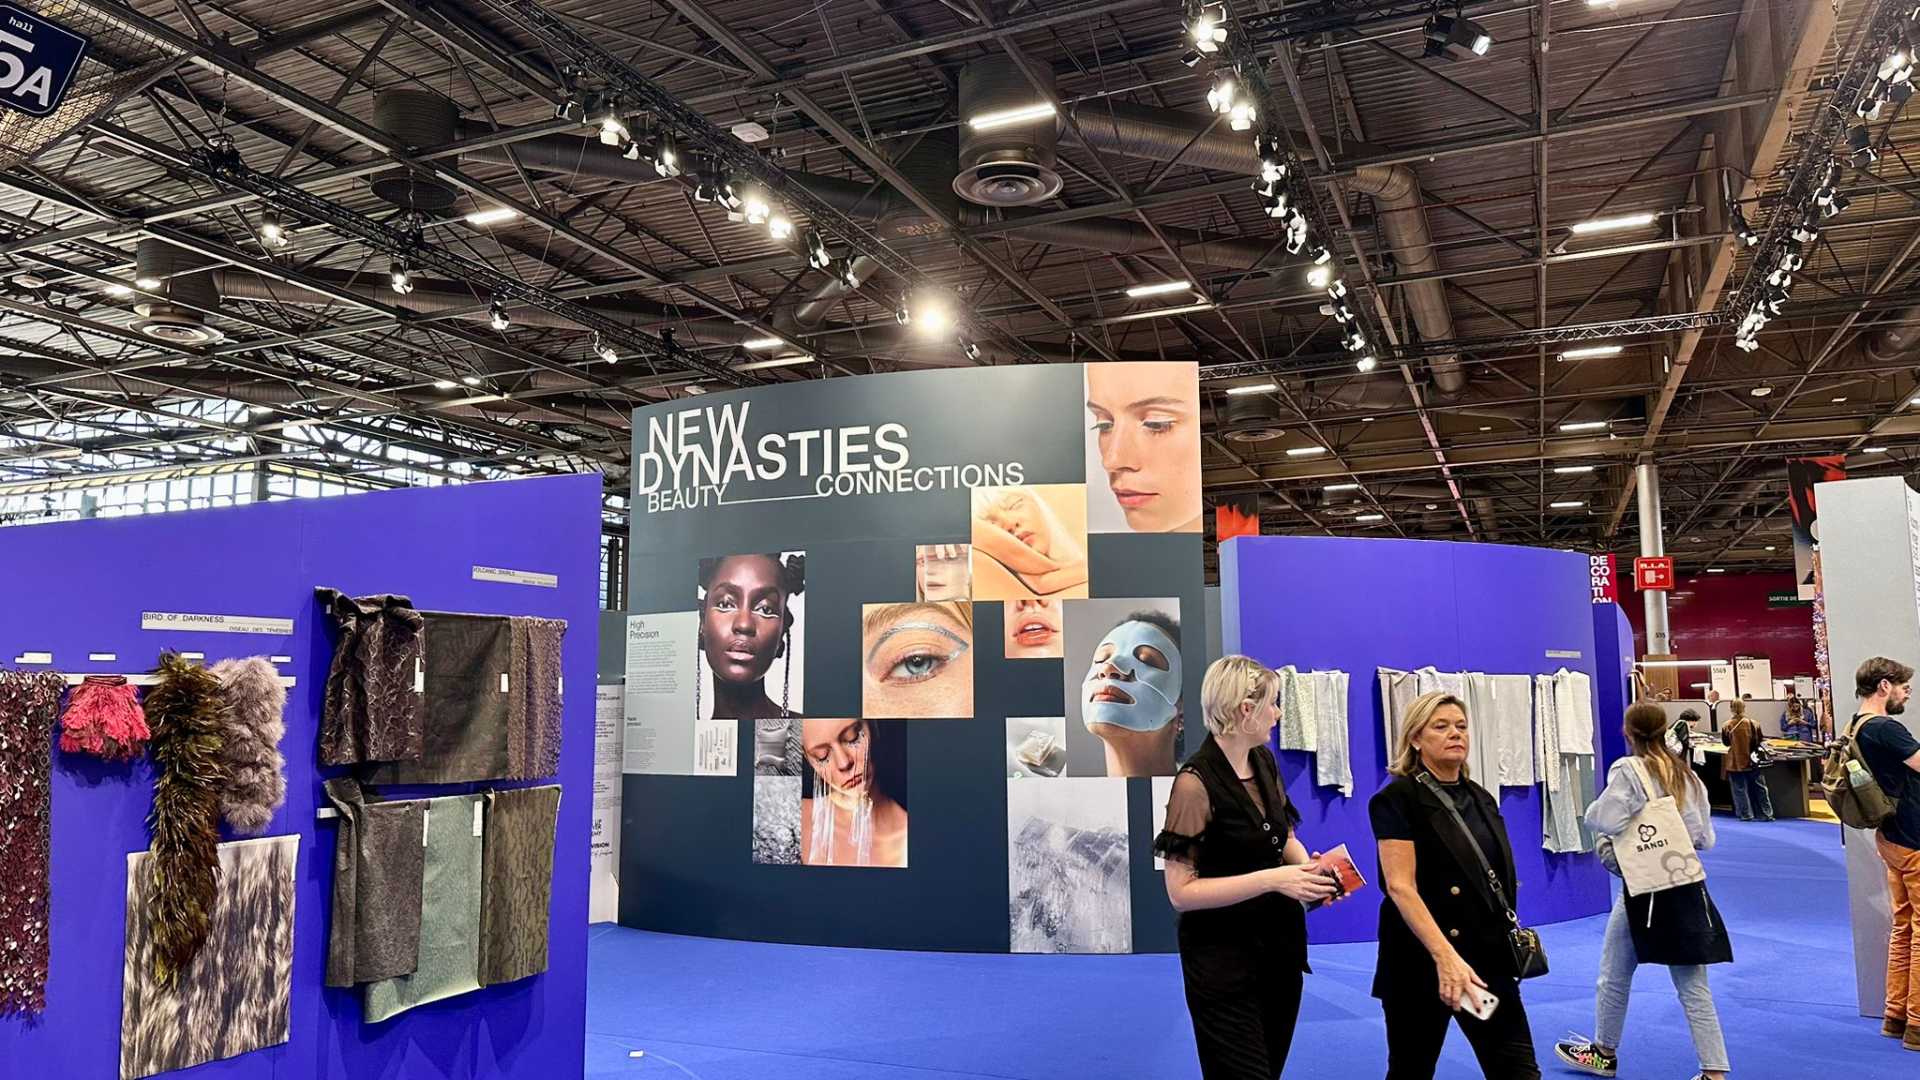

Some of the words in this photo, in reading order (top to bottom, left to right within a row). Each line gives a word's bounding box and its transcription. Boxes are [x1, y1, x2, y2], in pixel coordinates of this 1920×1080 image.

[8, 16, 34, 34] hall
[647, 400, 751, 454] NEW
[638, 422, 912, 496] DYNASTIES
[815, 461, 1025, 498] CONNECTIONS
[647, 483, 729, 513] BEAUTY
[143, 613, 163, 621] BIRD
[182, 615, 225, 623] DARKNESS
[630, 620, 645, 632] High
[629, 630, 660, 640] Precision
